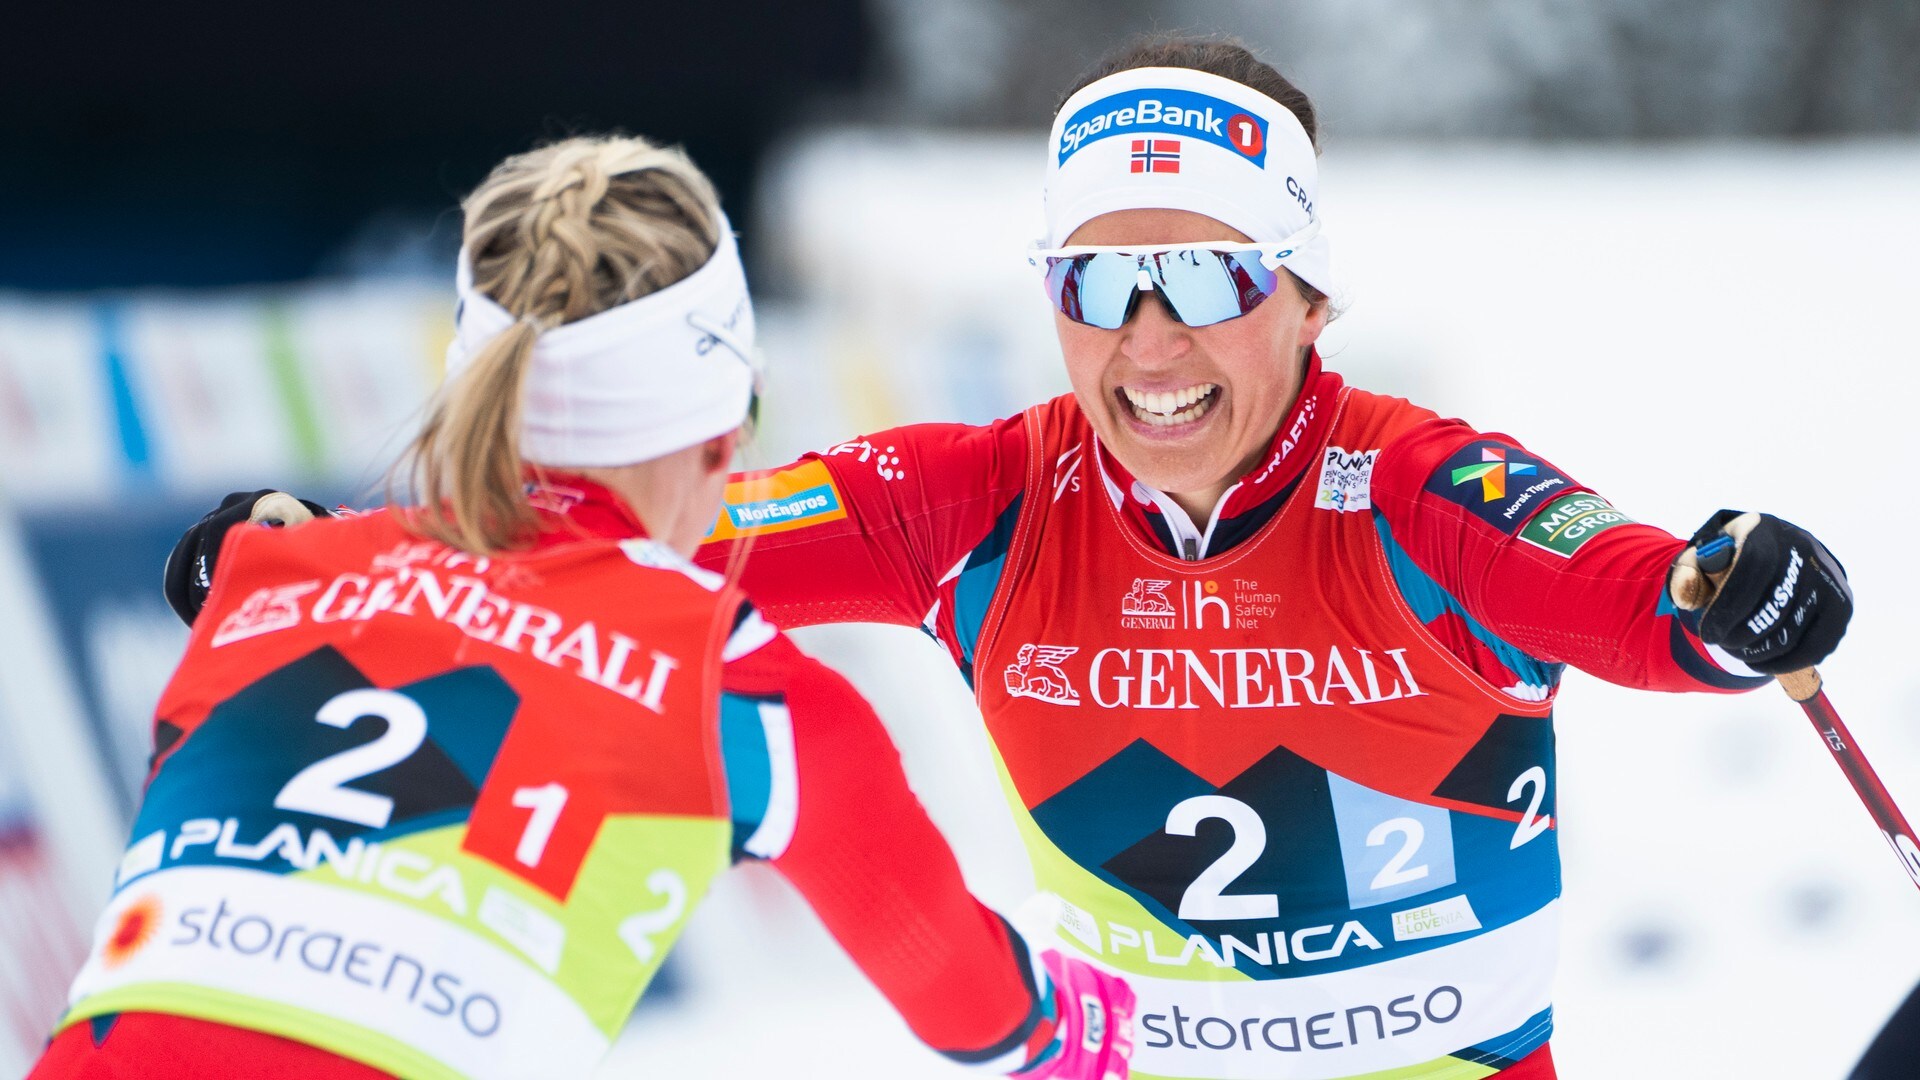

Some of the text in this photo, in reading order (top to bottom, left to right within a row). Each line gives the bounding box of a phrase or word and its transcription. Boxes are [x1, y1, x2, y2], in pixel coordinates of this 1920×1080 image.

[1061, 99, 1253, 153] SpareBank 1
[736, 494, 828, 523] NorEngros
[1503, 477, 1564, 520] Norsk Tipping
[1233, 578, 1258, 590] The
[1234, 592, 1281, 604] Human
[1235, 604, 1277, 618] Safety
[312, 568, 679, 714] GENERALI
[1121, 617, 1176, 630] GENERALI
[1236, 617, 1259, 629] Net
[1088, 645, 1430, 710] GENERALI
[273, 688, 429, 829] 2
[1823, 726, 1848, 752] TCS
[511, 782, 570, 869] 1
[1506, 765, 1552, 850] 2
[169, 817, 469, 916] PLANICA
[1165, 795, 1280, 920] 2
[1365, 816, 1430, 891] 2
[617, 869, 687, 965] 2
[1107, 920, 1384, 968] PLANICA
[1396, 907, 1437, 925] I FEEL
[170, 898, 501, 1040] storaenso
[1142, 985, 1463, 1052] storaenso
